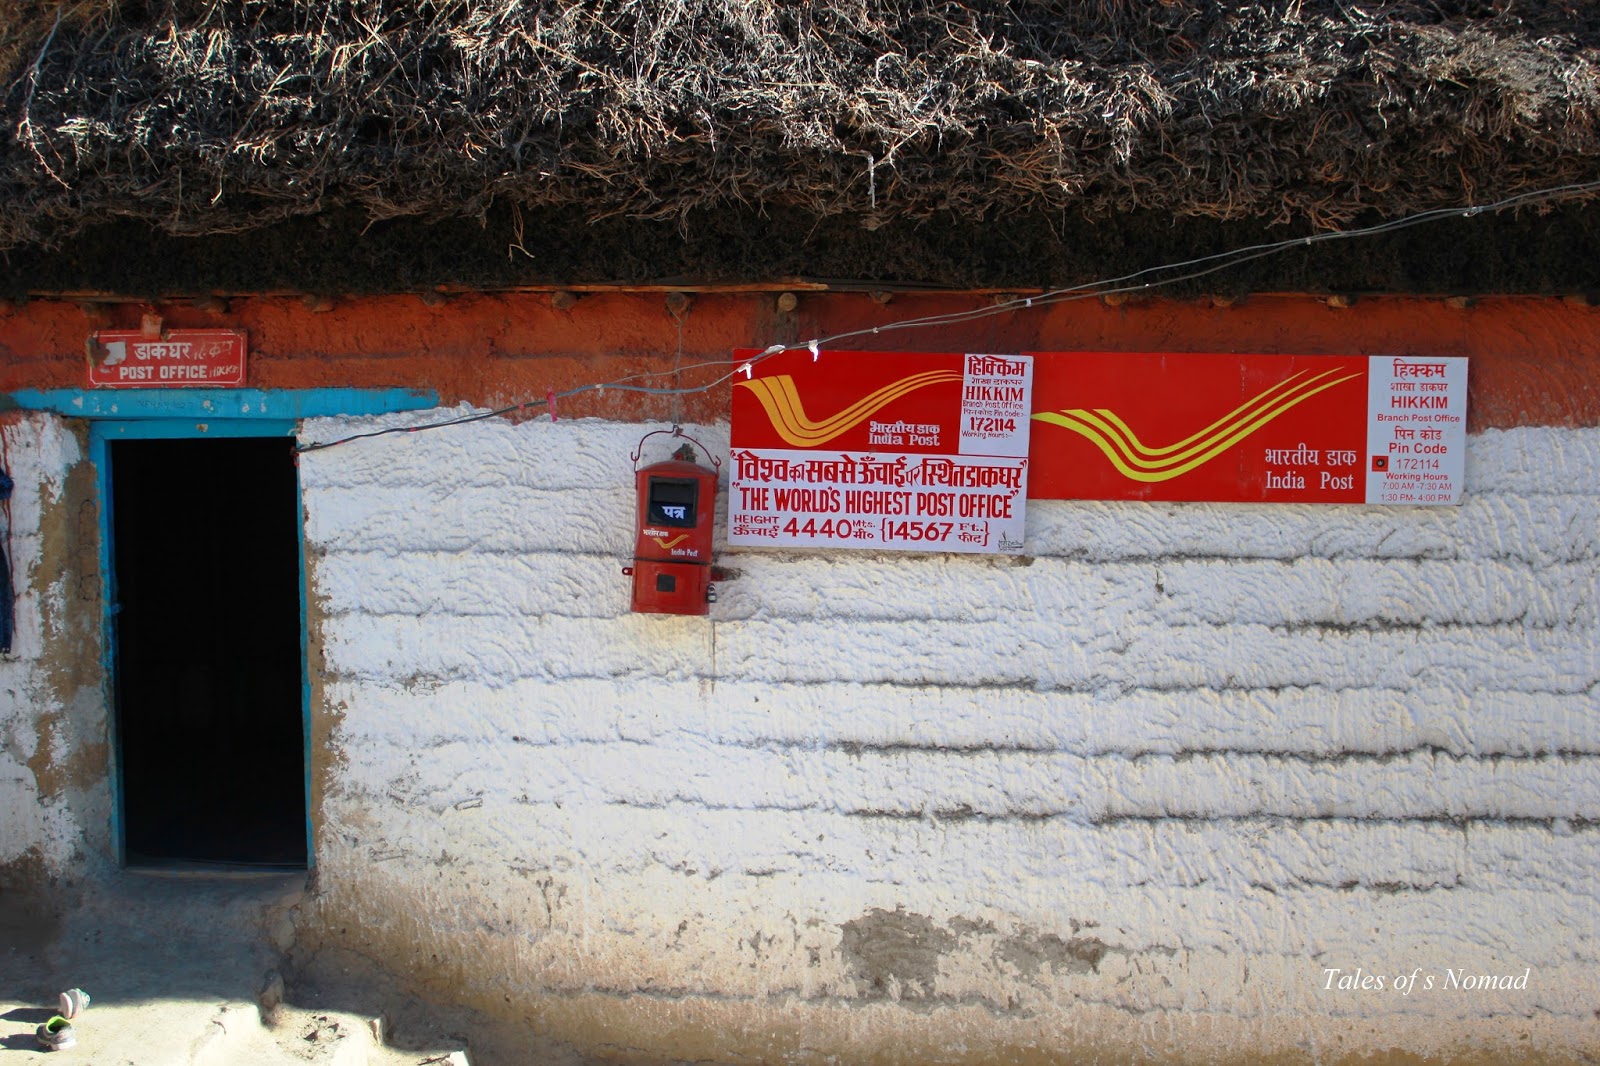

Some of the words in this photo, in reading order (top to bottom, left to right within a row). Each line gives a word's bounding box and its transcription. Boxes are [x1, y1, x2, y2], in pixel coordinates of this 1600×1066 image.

[133, 342, 192, 360] डाकघर
[120, 366, 154, 379] POST
[160, 365, 207, 379] OFFICE
[965, 386, 1024, 402] HIKKIM
[1390, 382, 1416, 392] शाखा
[1419, 382, 1449, 393] डाकघर
[963, 400, 983, 408] Branch
[1001, 402, 1024, 410] Office
[1391, 396, 1448, 409] HIKKIM
[970, 417, 1016, 432] 172114
[1377, 413, 1409, 422] Branch
[1411, 413, 1432, 422] Post
[1434, 414, 1460, 423] Office
[869, 420, 915, 433] भारतीय
[916, 424, 940, 434] डाक
[1394, 426, 1415, 440] पिन
[1420, 426, 1442, 441] कोड
[868, 432, 903, 445] India
[908, 434, 940, 446] Post
[962, 430, 987, 440] Working
[1265, 443, 1319, 466] भारतीय
[1325, 450, 1357, 466] डाक
[1389, 442, 1409, 454] Pin
[1413, 442, 1448, 454] Code
[805, 454, 858, 483] सबसे
[1396, 458, 1439, 470] 172114
[1266, 470, 1305, 489] India
[1320, 471, 1354, 490] Post
[1386, 472, 1420, 481] Working
[1382, 482, 1399, 490] 7:00
[1401, 482, 1415, 490] AM
[1438, 483, 1452, 491] AM
[845, 490, 912, 516] HIGHEST
[917, 492, 956, 517] POST
[1418, 494, 1436, 502] 4:00
[1438, 494, 1451, 502] PM
[662, 505, 686, 520] पत्र
[734, 514, 780, 524] HEIGHT
[783, 517, 852, 539] 4440
